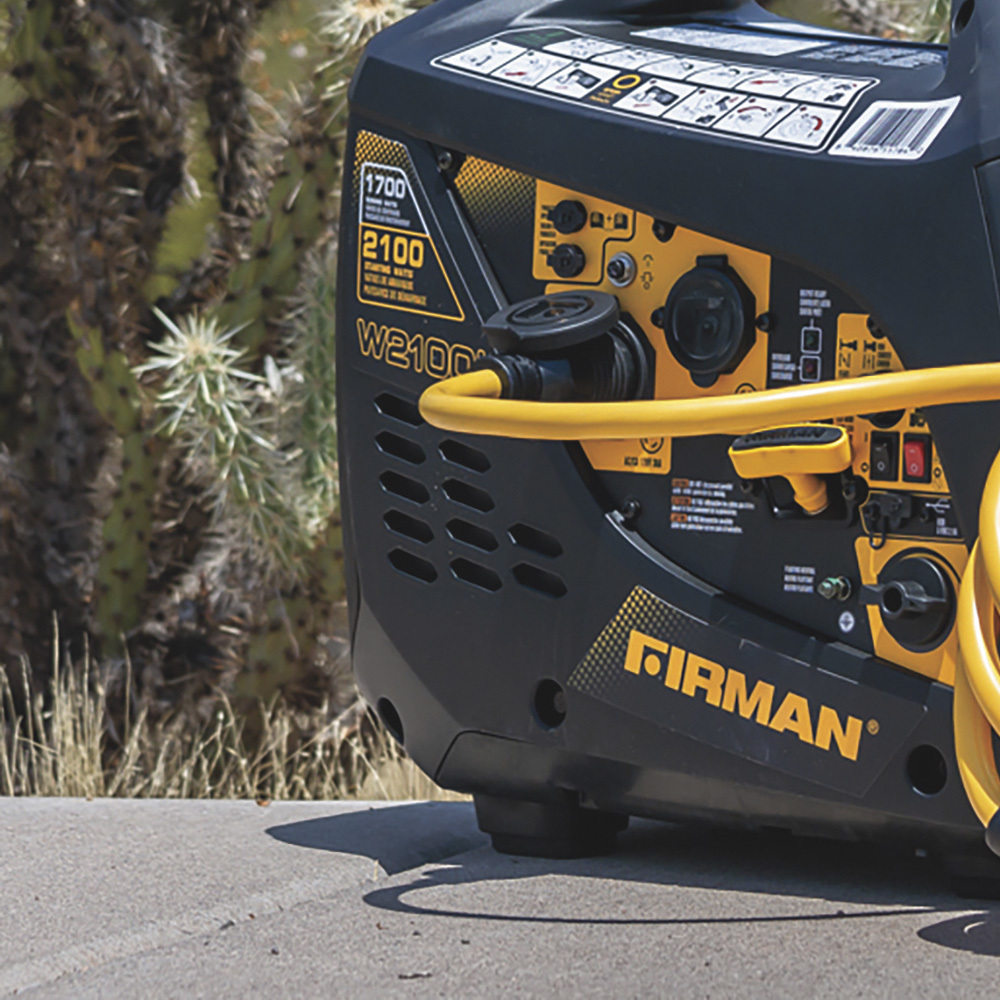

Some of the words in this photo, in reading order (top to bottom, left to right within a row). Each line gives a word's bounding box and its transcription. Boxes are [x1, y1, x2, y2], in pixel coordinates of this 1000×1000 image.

[366, 173, 406, 199] 1700
[363, 230, 424, 268] 2100
[356, 318, 487, 379] W2100
[624, 629, 863, 761] FIRMAN
